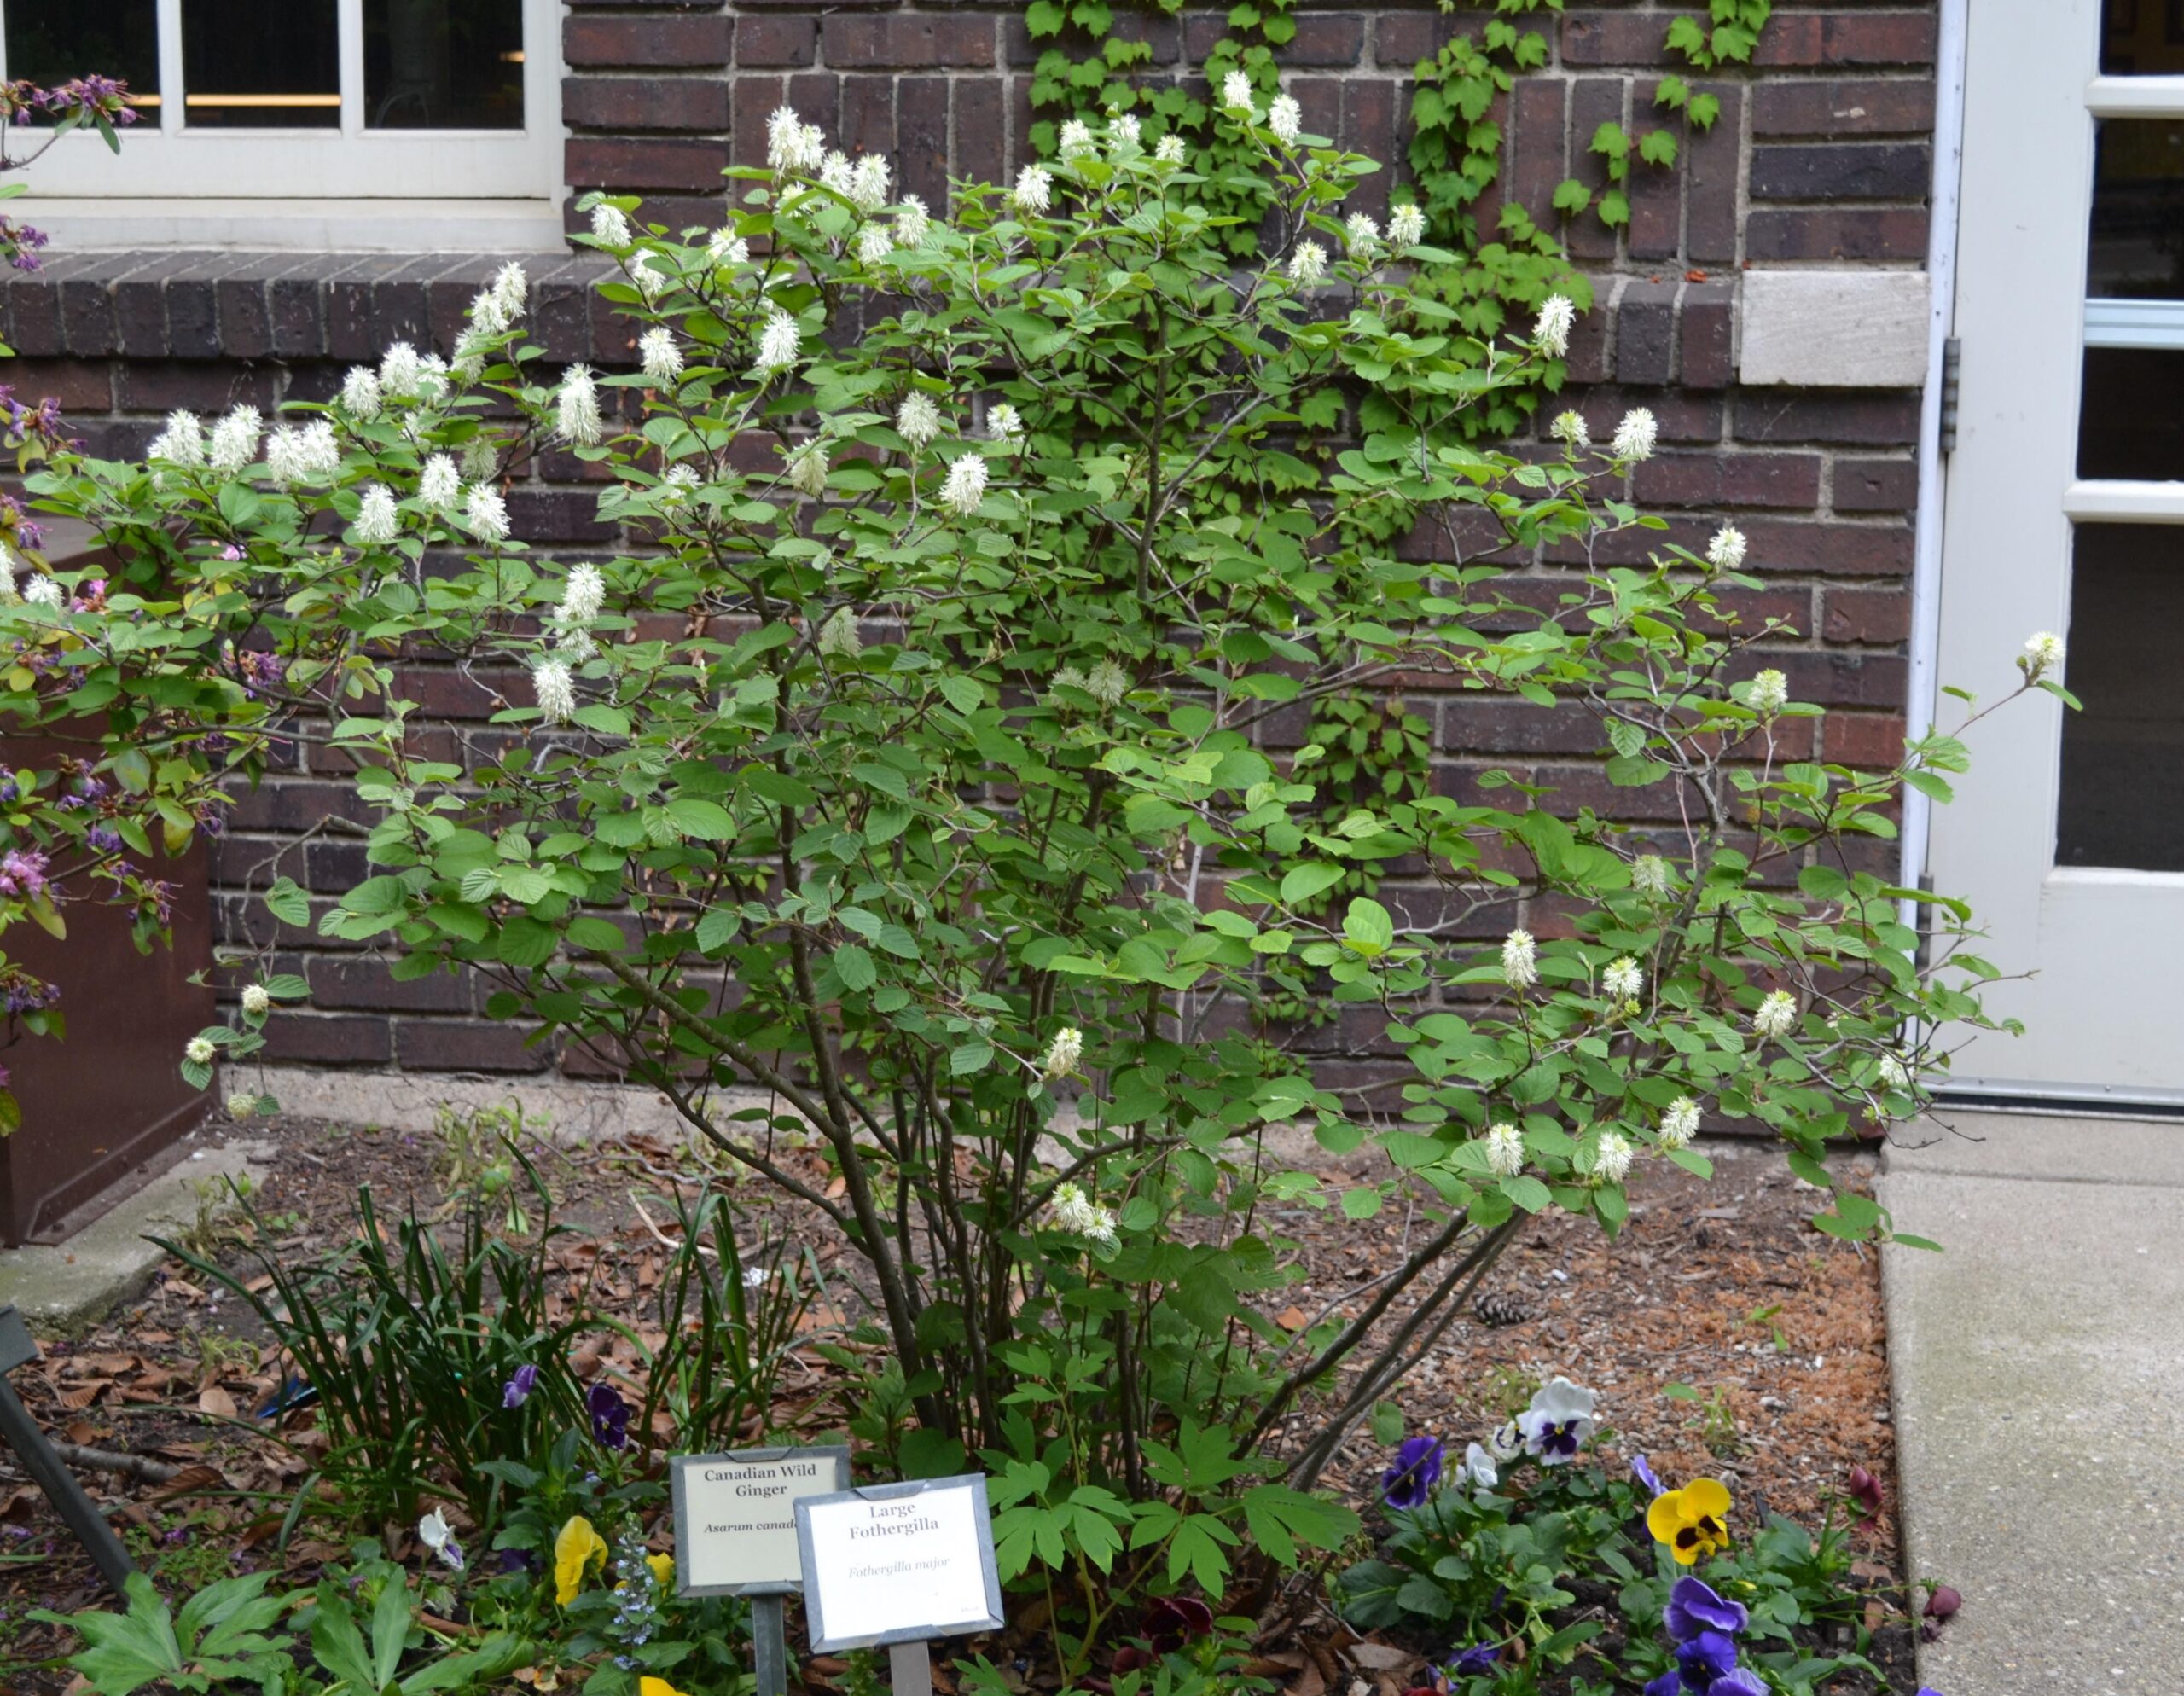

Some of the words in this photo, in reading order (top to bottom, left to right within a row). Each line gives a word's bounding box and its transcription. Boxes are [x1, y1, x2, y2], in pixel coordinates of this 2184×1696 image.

[704, 1467, 776, 1482] Canadian
[780, 1463, 816, 1478] Wild
[735, 1484, 787, 1498] Ginger
[869, 1504, 915, 1519] Large
[704, 1523, 753, 1533] Asarum
[850, 1517, 939, 1540] Fothergilla
[849, 1560, 912, 1578] Fothergilla
[915, 1556, 950, 1571] major
